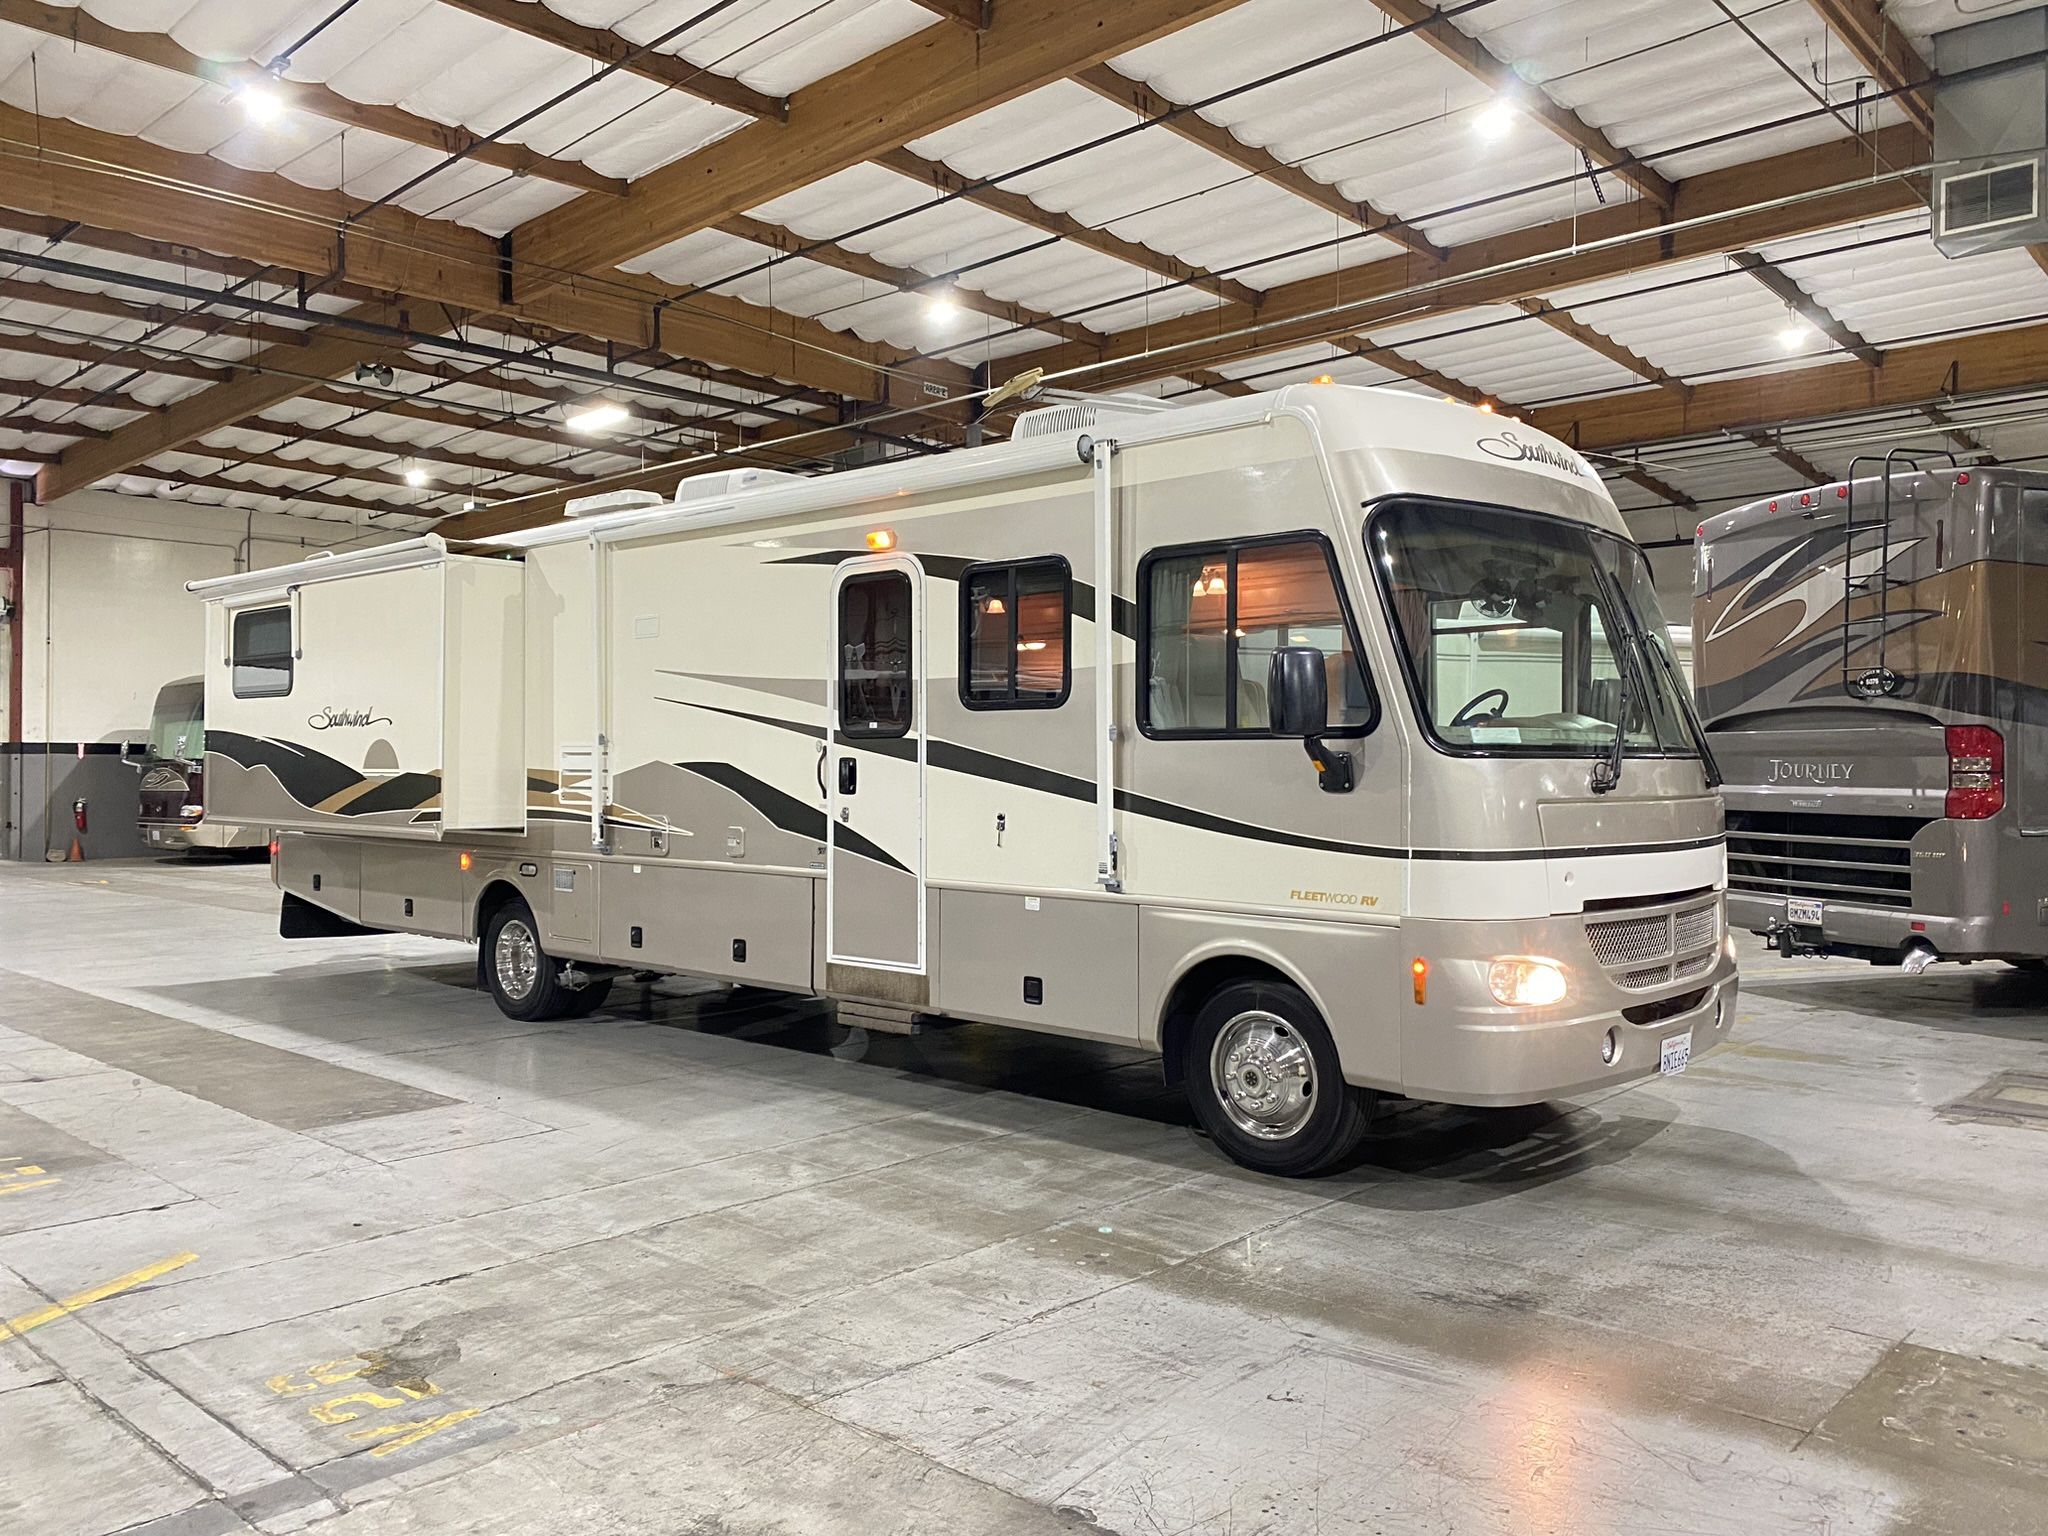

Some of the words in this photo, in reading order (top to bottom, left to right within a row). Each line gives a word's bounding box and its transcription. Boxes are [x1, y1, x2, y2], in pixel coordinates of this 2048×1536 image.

[1476, 431, 1584, 477] Southwind
[307, 705, 393, 730] Southwind
[1767, 759, 1854, 784] JOURNEY
[1290, 890, 1357, 905] FLEETWOOD
[1360, 895, 1379, 906] RV
